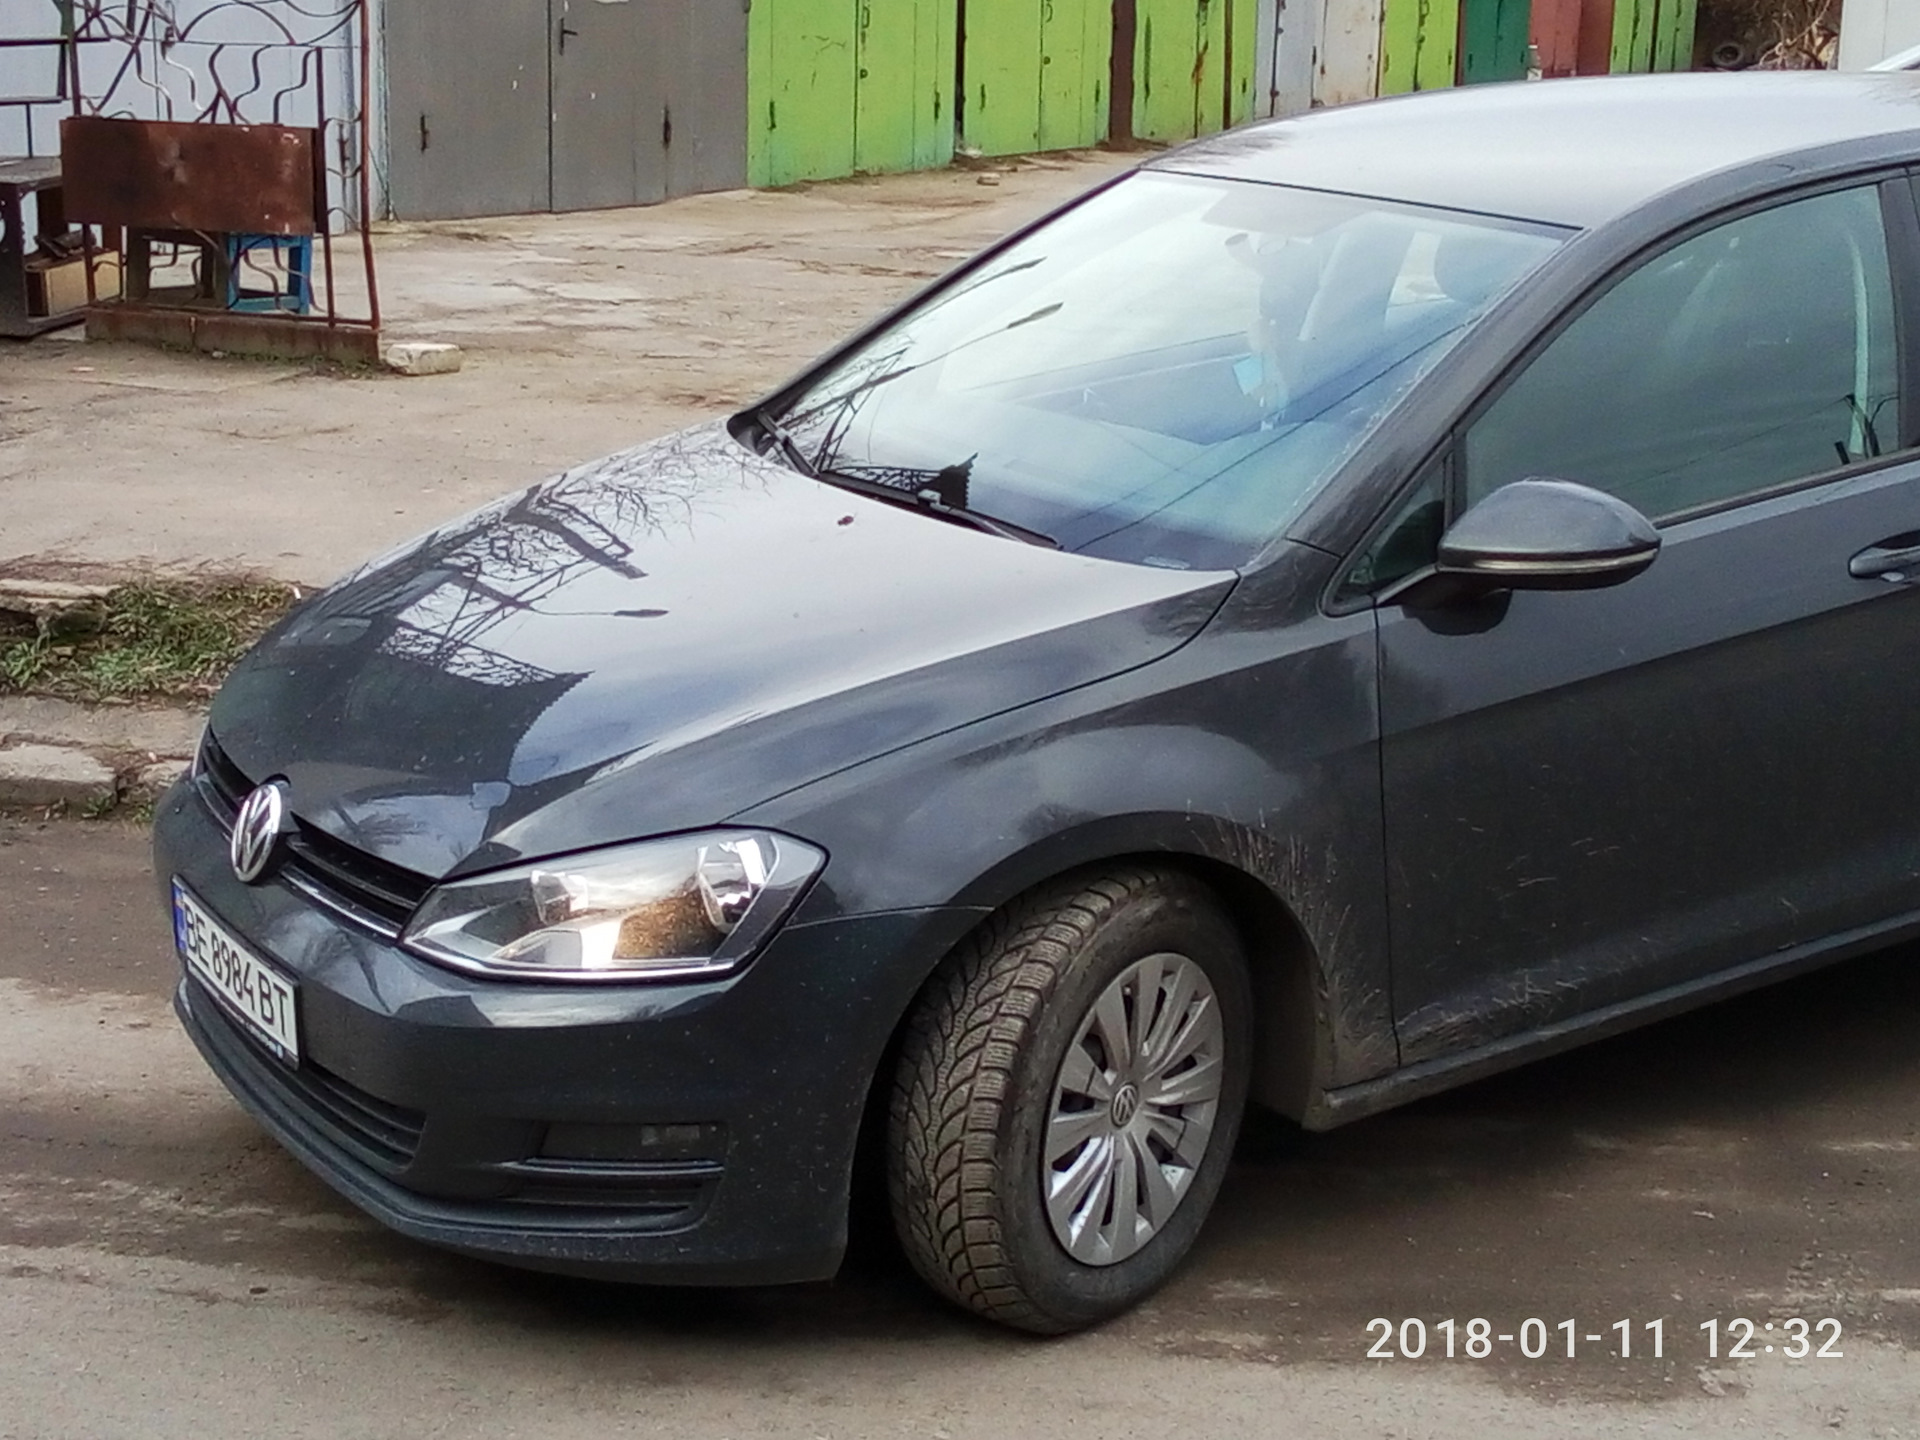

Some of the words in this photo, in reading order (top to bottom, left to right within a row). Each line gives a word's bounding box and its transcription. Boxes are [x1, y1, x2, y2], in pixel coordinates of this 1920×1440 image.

[184, 903, 210, 969] BE
[211, 931, 255, 1012] 8984
[257, 969, 289, 1038] BT
